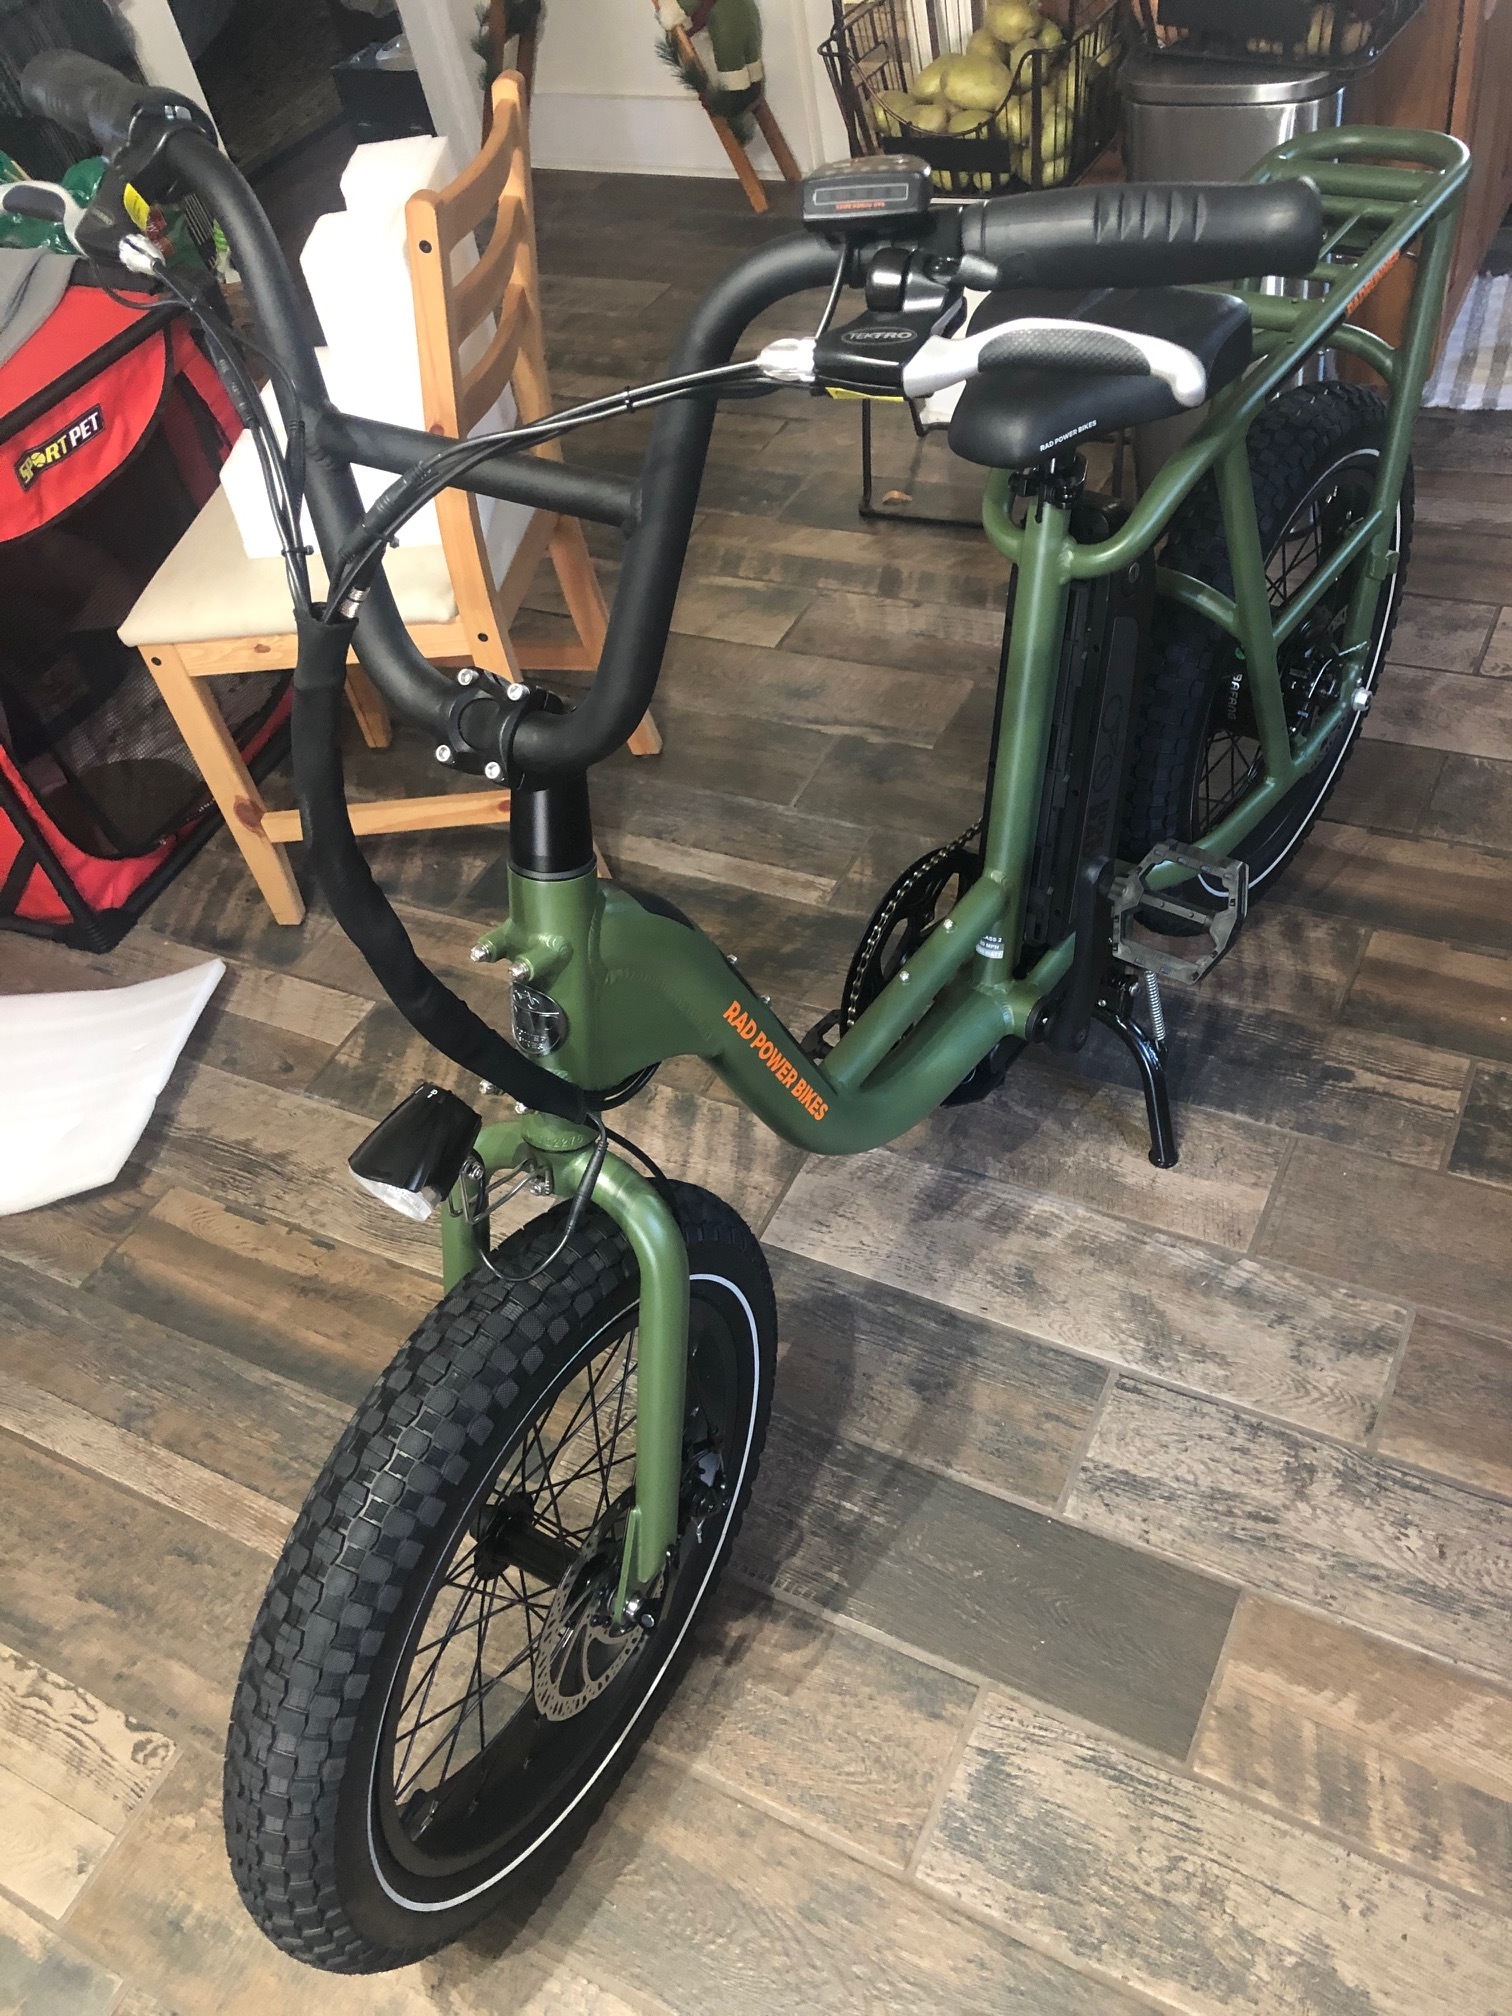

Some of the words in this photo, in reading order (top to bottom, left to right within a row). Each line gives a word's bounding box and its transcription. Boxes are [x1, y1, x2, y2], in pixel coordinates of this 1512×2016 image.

[849, 331, 913, 340] TEKTRO
[19, 434, 68, 484] SPORT
[68, 411, 99, 448] PET
[1039, 440, 1055, 452] RAD
[1054, 428, 1078, 445] POWER
[1077, 419, 1097, 433] BIKES
[722, 1000, 757, 1040] RAD
[749, 1030, 799, 1089] POWER
[790, 1077, 829, 1121] BIKES
